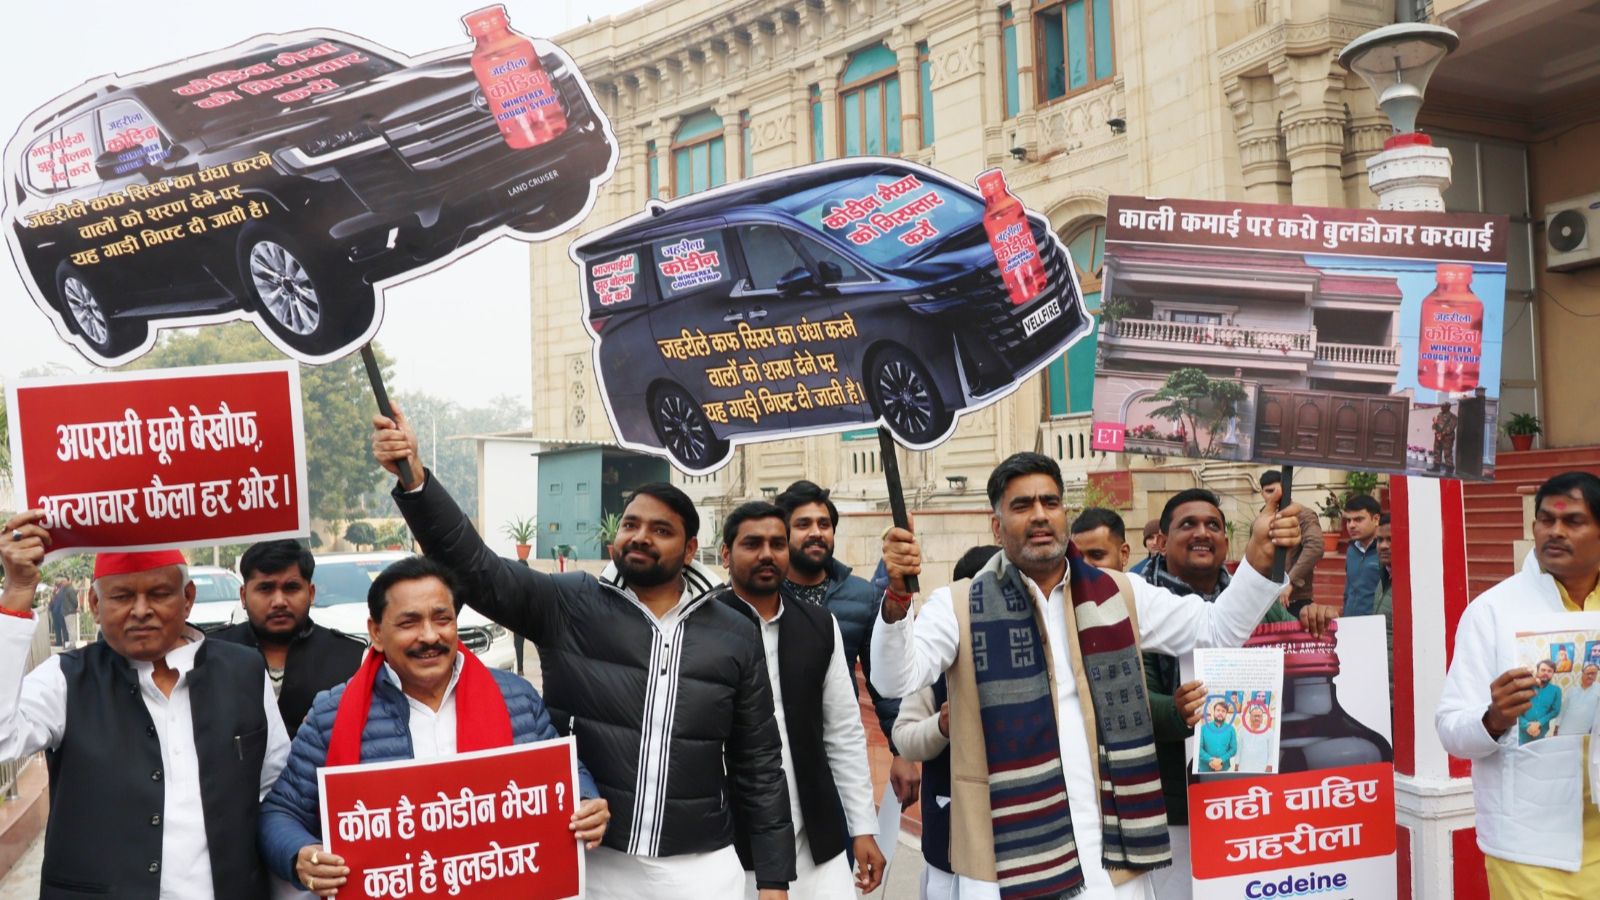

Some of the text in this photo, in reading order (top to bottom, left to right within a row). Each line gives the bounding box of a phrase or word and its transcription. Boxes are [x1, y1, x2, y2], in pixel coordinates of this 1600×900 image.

[491, 57, 528, 77] जहरीला
[488, 70, 544, 98] कोडिन
[193, 90, 243, 109] को
[497, 95, 556, 121] COUGH SYRUP
[107, 112, 143, 130] जहरीला
[106, 125, 158, 152] कोडिन
[24, 199, 87, 229] जहरीले
[90, 193, 125, 212] कफ
[126, 180, 170, 202] सिरप
[172, 173, 196, 189] का
[232, 151, 272, 173] करने
[507, 169, 560, 197] LAND CRUISER
[78, 184, 243, 239] वालों को शरण देने पर
[823, 174, 922, 229] कोडीन भैय्या
[848, 192, 943, 244] को गिरफ्तार
[1118, 206, 1494, 252] काली कमाई पर करो बुलडोजर करवाई
[70, 248, 100, 265] यह
[101, 235, 140, 254] गाड़ी
[140, 225, 186, 248] गिफ्ट
[186, 216, 207, 233] दी
[208, 205, 246, 228] जाती
[663, 240, 704, 255] जहरीला
[995, 231, 1034, 260] कोडीन
[660, 251, 719, 275] कोडीन
[676, 269, 712, 281] WINCEREX
[594, 273, 634, 294] झूठ बोलना
[672, 272, 720, 289] COUGH SYRUP
[1024, 302, 1060, 332] VELLFIRE
[1435, 312, 1472, 323] जहरीला
[657, 312, 858, 360] जहरीले कफ सिरप का धंधा करने
[1425, 323, 1480, 343] कोडिन
[706, 350, 838, 388] वालों को शरण देने पर
[1421, 352, 1480, 363] COUGH SYRUP
[703, 402, 728, 423] यह
[726, 389, 760, 424] गाड़ी
[758, 387, 797, 415] गिफ्ट
[797, 383, 812, 409] दी
[811, 378, 845, 406] जाती
[56, 408, 143, 462] अपराधी
[147, 406, 185, 465] घूमे
[1097, 428, 1122, 444] ET
[38, 488, 139, 530] अत्याचार
[142, 474, 195, 520] फैला
[200, 479, 232, 518] हर
[337, 800, 391, 842] कौन
[397, 795, 415, 840] है
[420, 787, 496, 832] कोडीन
[501, 779, 548, 819] भैया
[1203, 776, 1379, 820] नही चाहिए
[1225, 823, 1363, 862] जहरीला
[363, 841, 540, 898] कहां है बुलडोजर
[1245, 872, 1347, 899] Codeine
